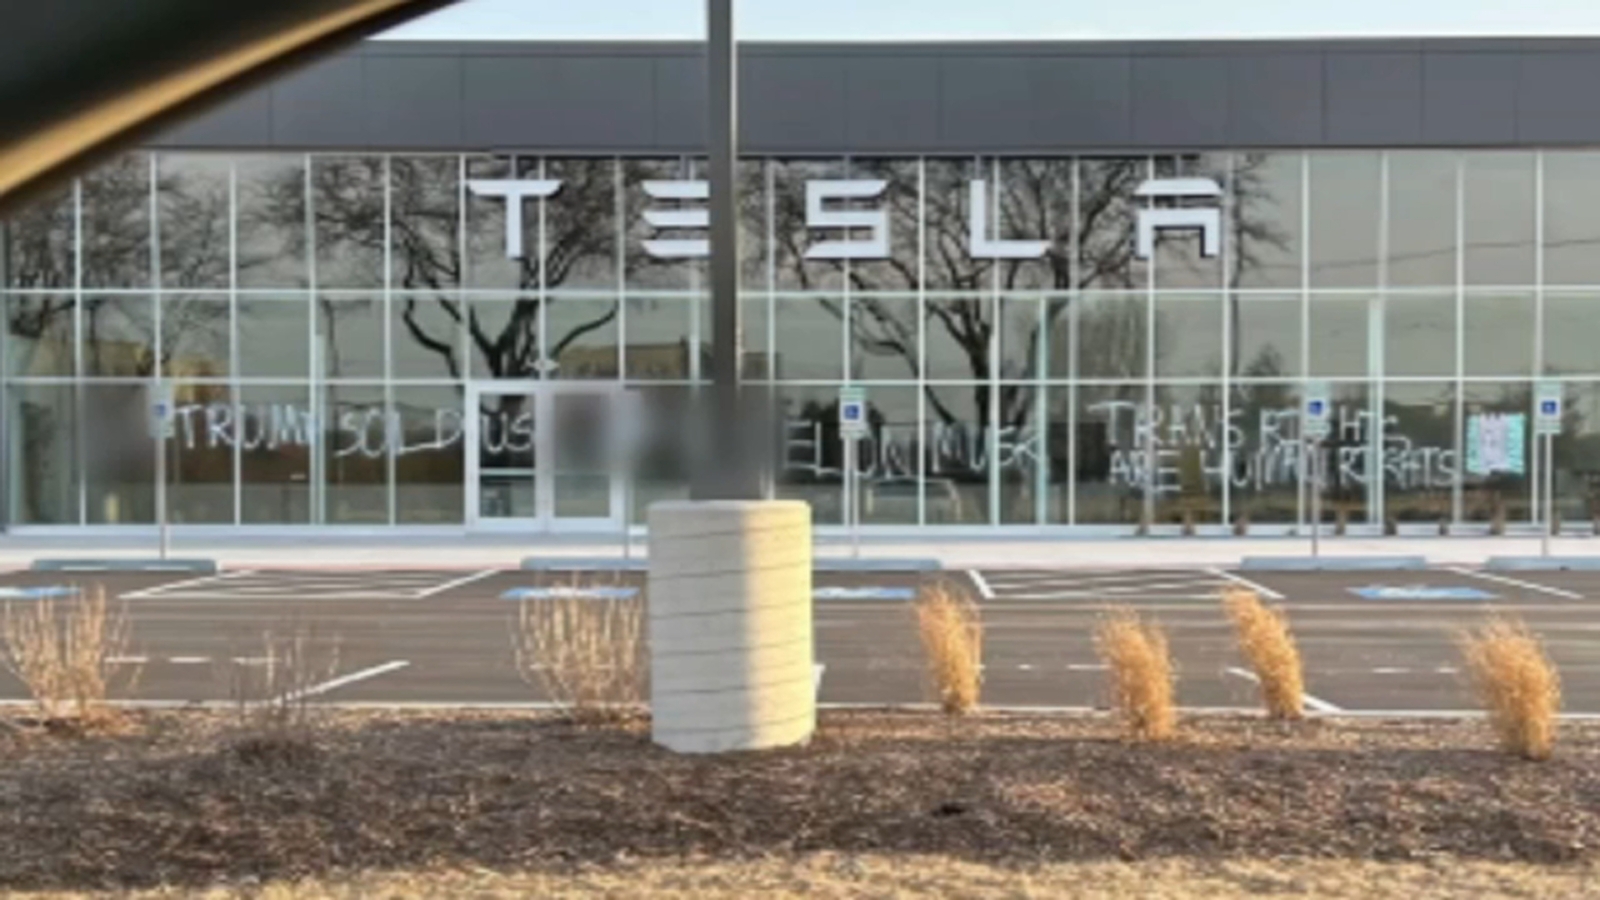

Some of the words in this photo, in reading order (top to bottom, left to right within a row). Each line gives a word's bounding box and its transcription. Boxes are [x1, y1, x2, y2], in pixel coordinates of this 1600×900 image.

[468, 179, 1222, 258] TESLA
[481, 411, 533, 455] US
[1087, 401, 1244, 448] TRANS
